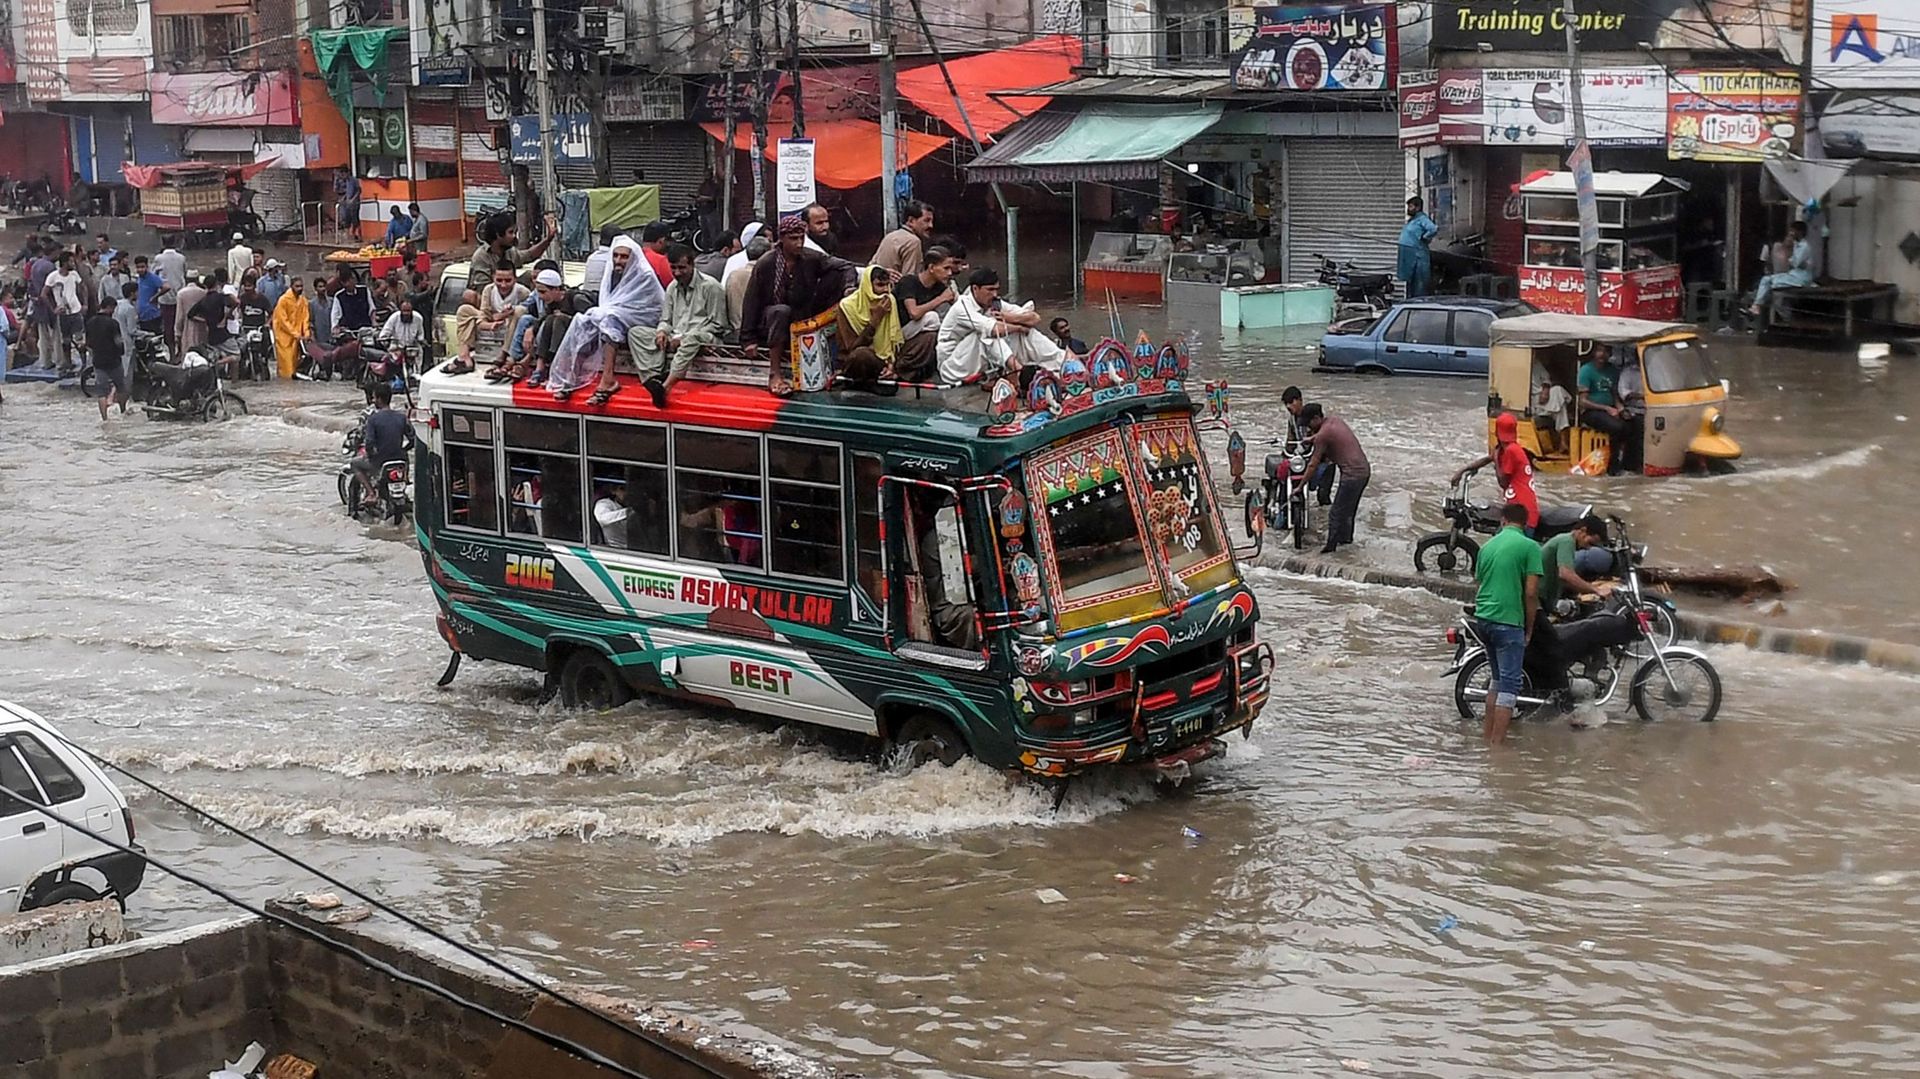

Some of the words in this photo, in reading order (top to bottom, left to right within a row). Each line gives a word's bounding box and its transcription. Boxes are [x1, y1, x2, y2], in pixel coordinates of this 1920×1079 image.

[1328, 10, 1384, 45] دربار
[1457, 8, 1544, 36] Training
[1507, 70, 1535, 81] ELECTRO
[1537, 70, 1560, 80] PALACE
[1704, 76, 1724, 91] 110
[1440, 86, 1481, 100] WAHID
[1183, 524, 1201, 553] 108
[505, 552, 555, 591] 2016
[624, 575, 675, 600] EXPRESS
[681, 577, 833, 626] ASMATULLAH
[730, 660, 793, 695] BEST
